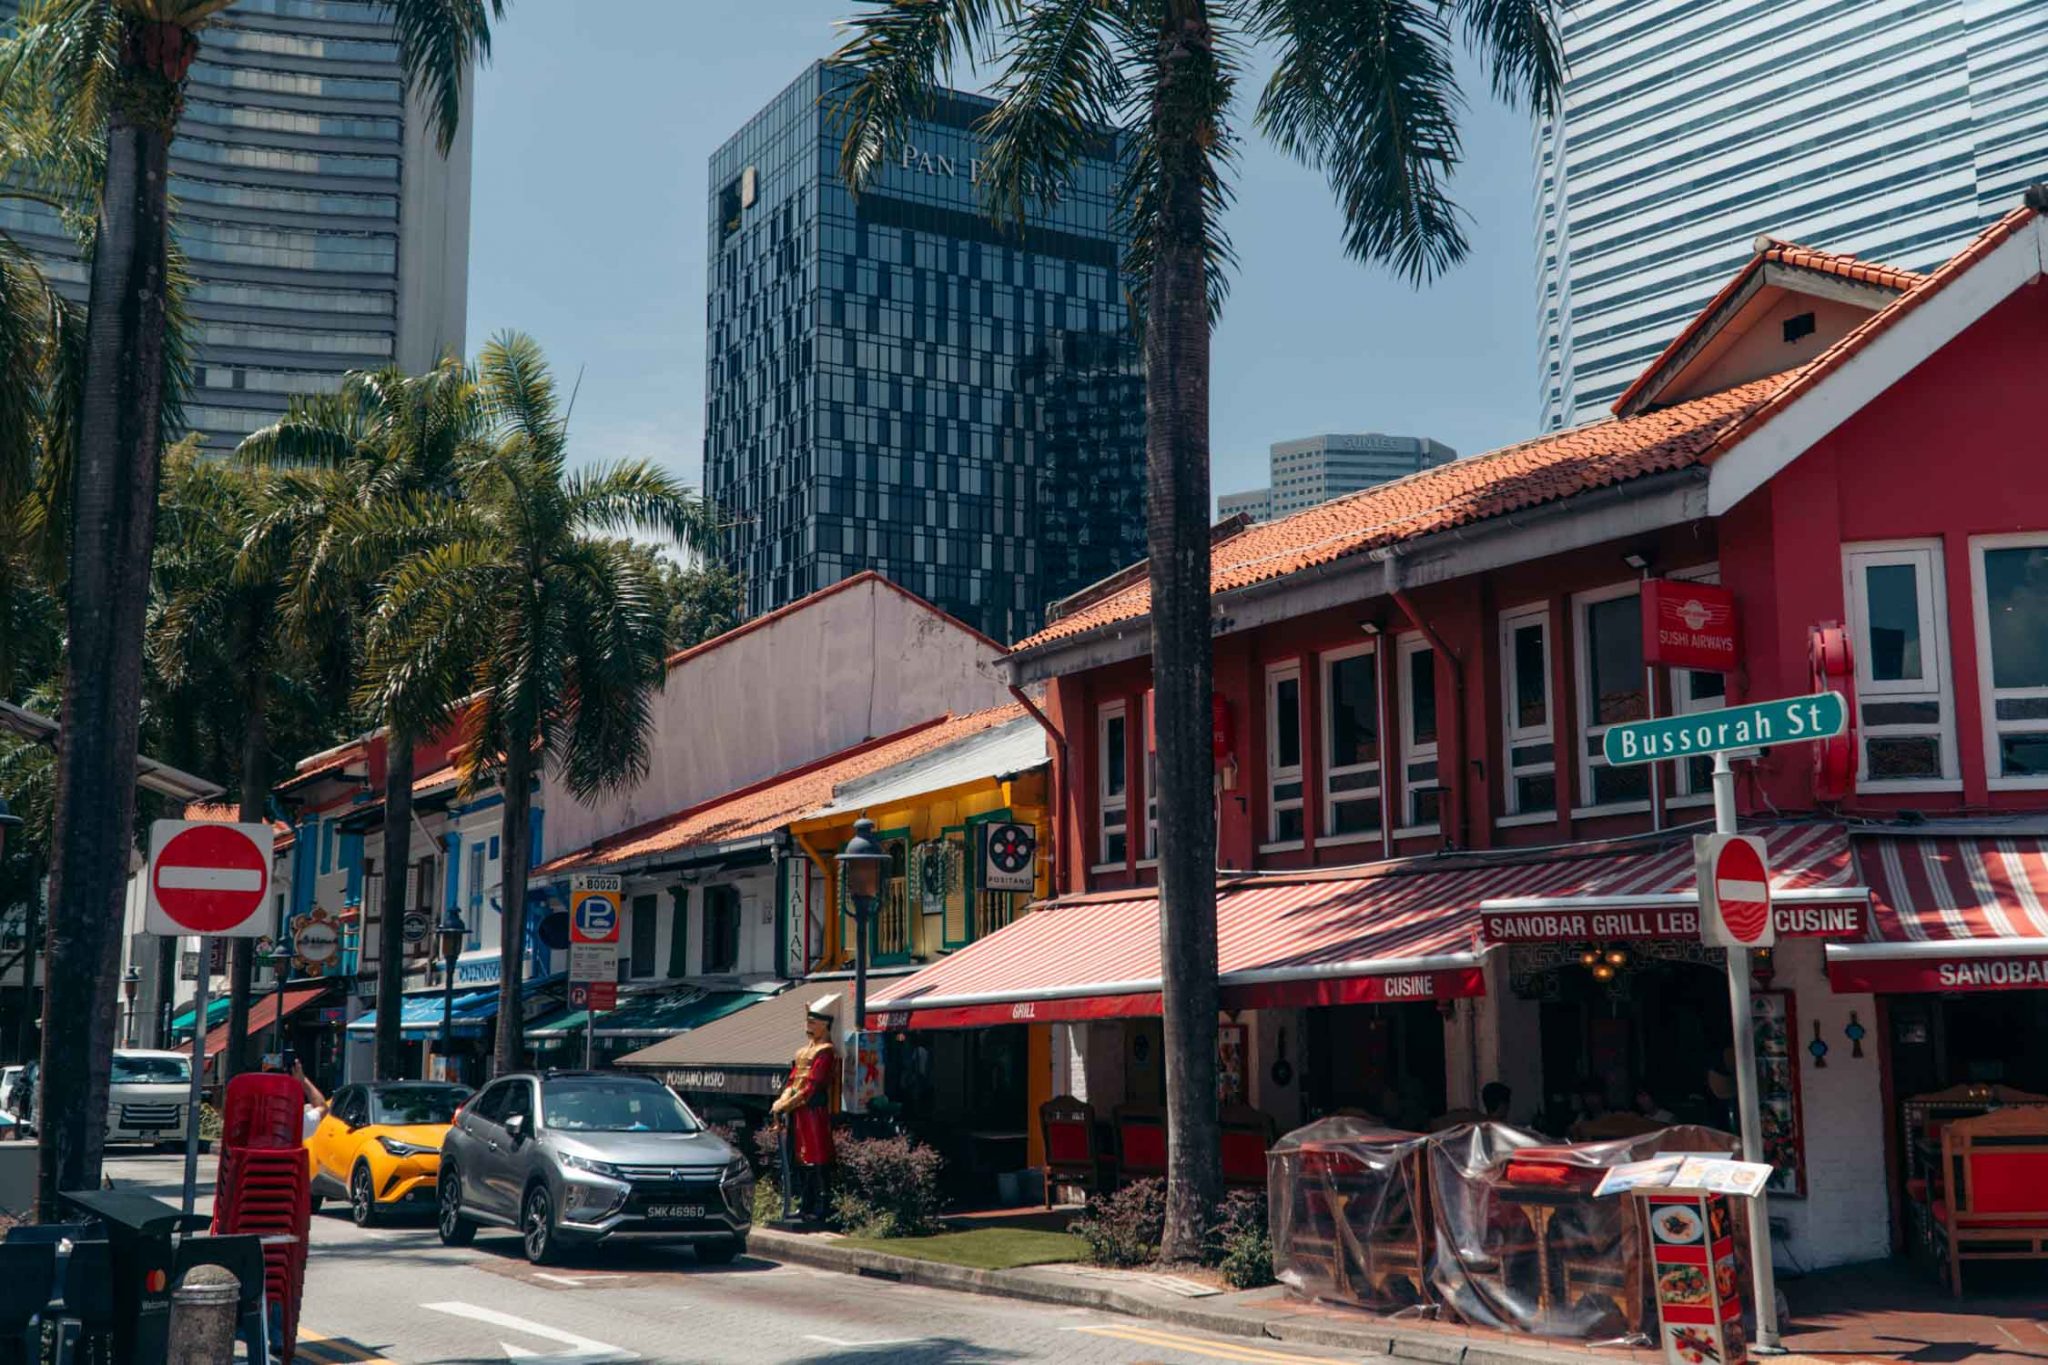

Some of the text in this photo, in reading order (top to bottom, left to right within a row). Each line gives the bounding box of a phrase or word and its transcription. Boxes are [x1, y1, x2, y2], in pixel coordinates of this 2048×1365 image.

[902, 144, 956, 178] PAN
[1659, 630, 1734, 652] SUSHI AIRWAYS
[1621, 703, 1823, 758] Bussorah St
[586, 879, 619, 890] 80020
[988, 876, 1031, 885] POSITANO
[791, 859, 802, 963] ITALIAN
[1490, 914, 1587, 938] SANOBAR
[1592, 913, 1652, 936] GRILL
[1774, 908, 1859, 932] CUSINE
[1384, 975, 1434, 997] CUSINE
[1012, 1002, 1035, 1020] GRILL
